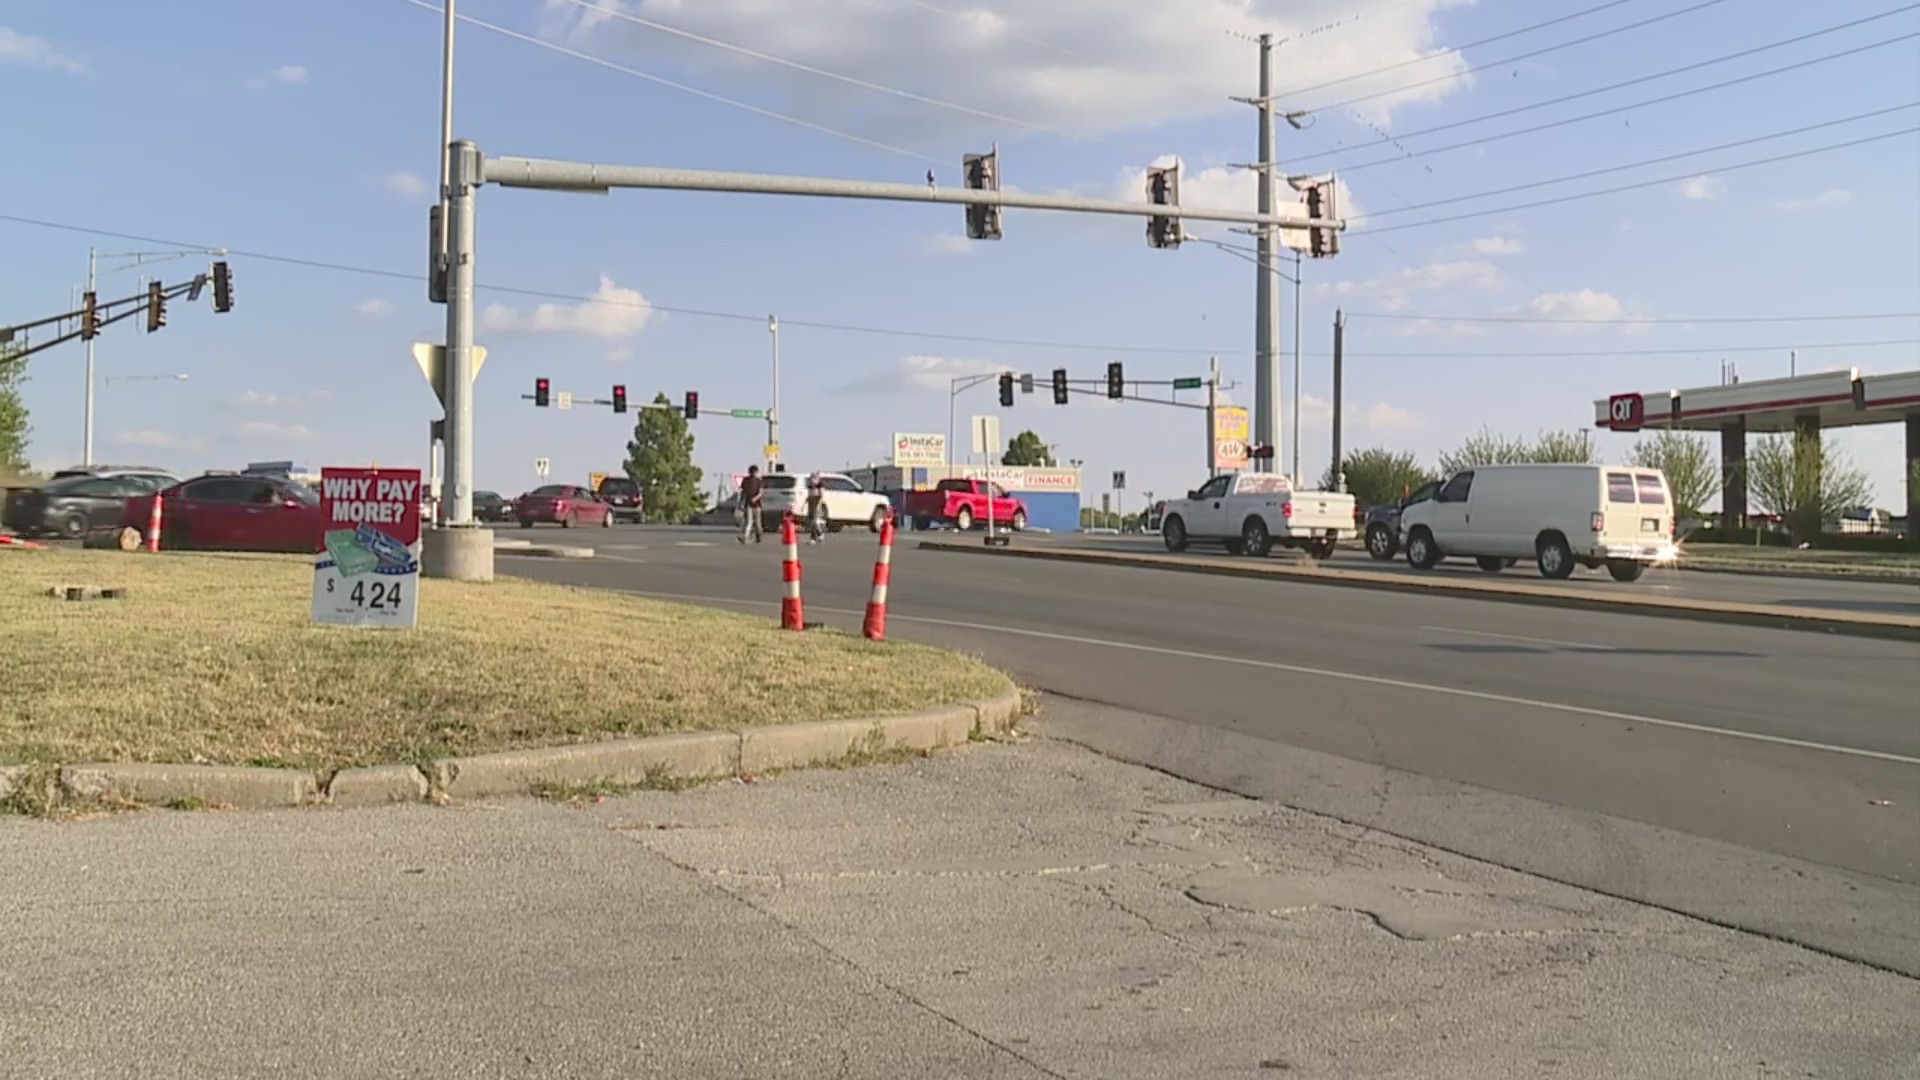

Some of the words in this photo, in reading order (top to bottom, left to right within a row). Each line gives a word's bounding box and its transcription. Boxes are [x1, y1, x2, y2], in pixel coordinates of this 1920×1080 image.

[1612, 399, 1633, 421] QT
[910, 436, 944, 447] InstaCar
[323, 478, 372, 499] WHY
[376, 480, 418, 501] PAY
[1028, 475, 1073, 485] FINANCE
[333, 501, 405, 523] MORE?
